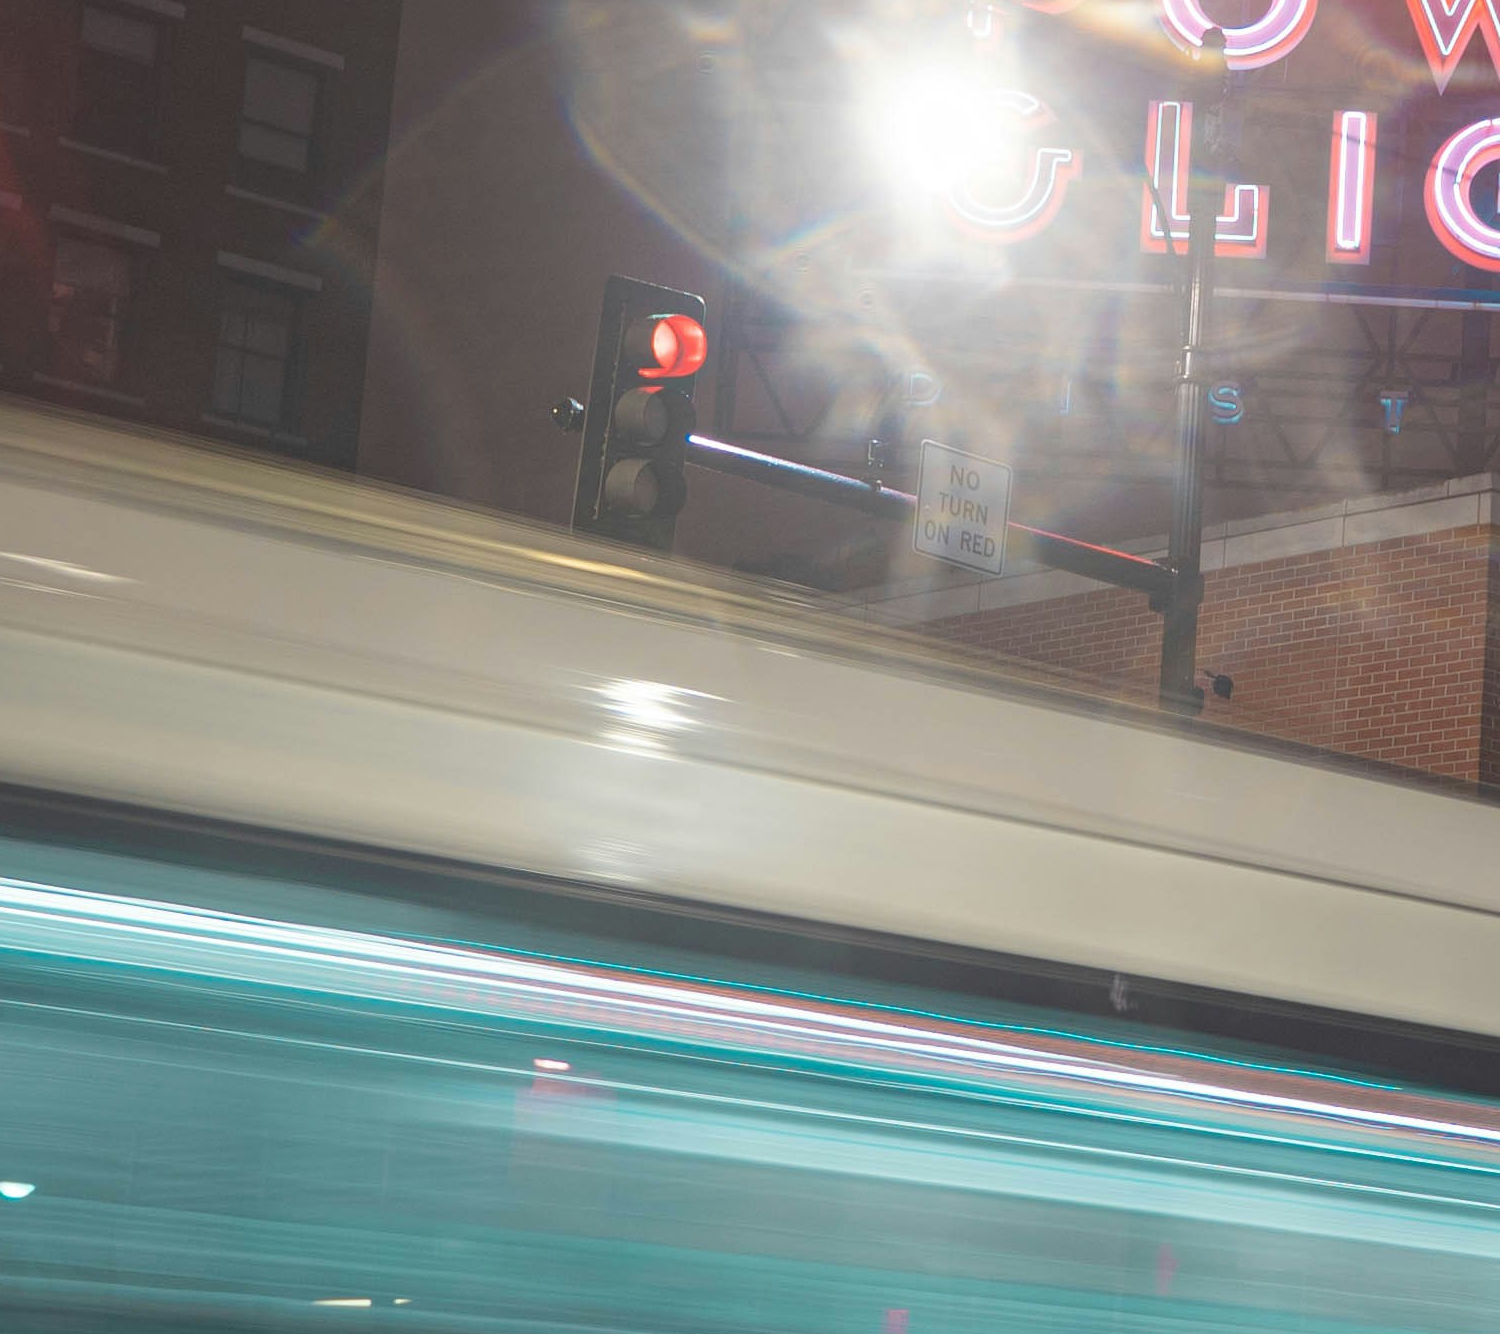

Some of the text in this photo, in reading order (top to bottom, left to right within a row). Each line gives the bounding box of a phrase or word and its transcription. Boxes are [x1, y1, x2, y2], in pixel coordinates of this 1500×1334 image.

[949, 464, 982, 492] NO
[939, 491, 990, 526] TURN
[923, 519, 997, 558] ON RED
